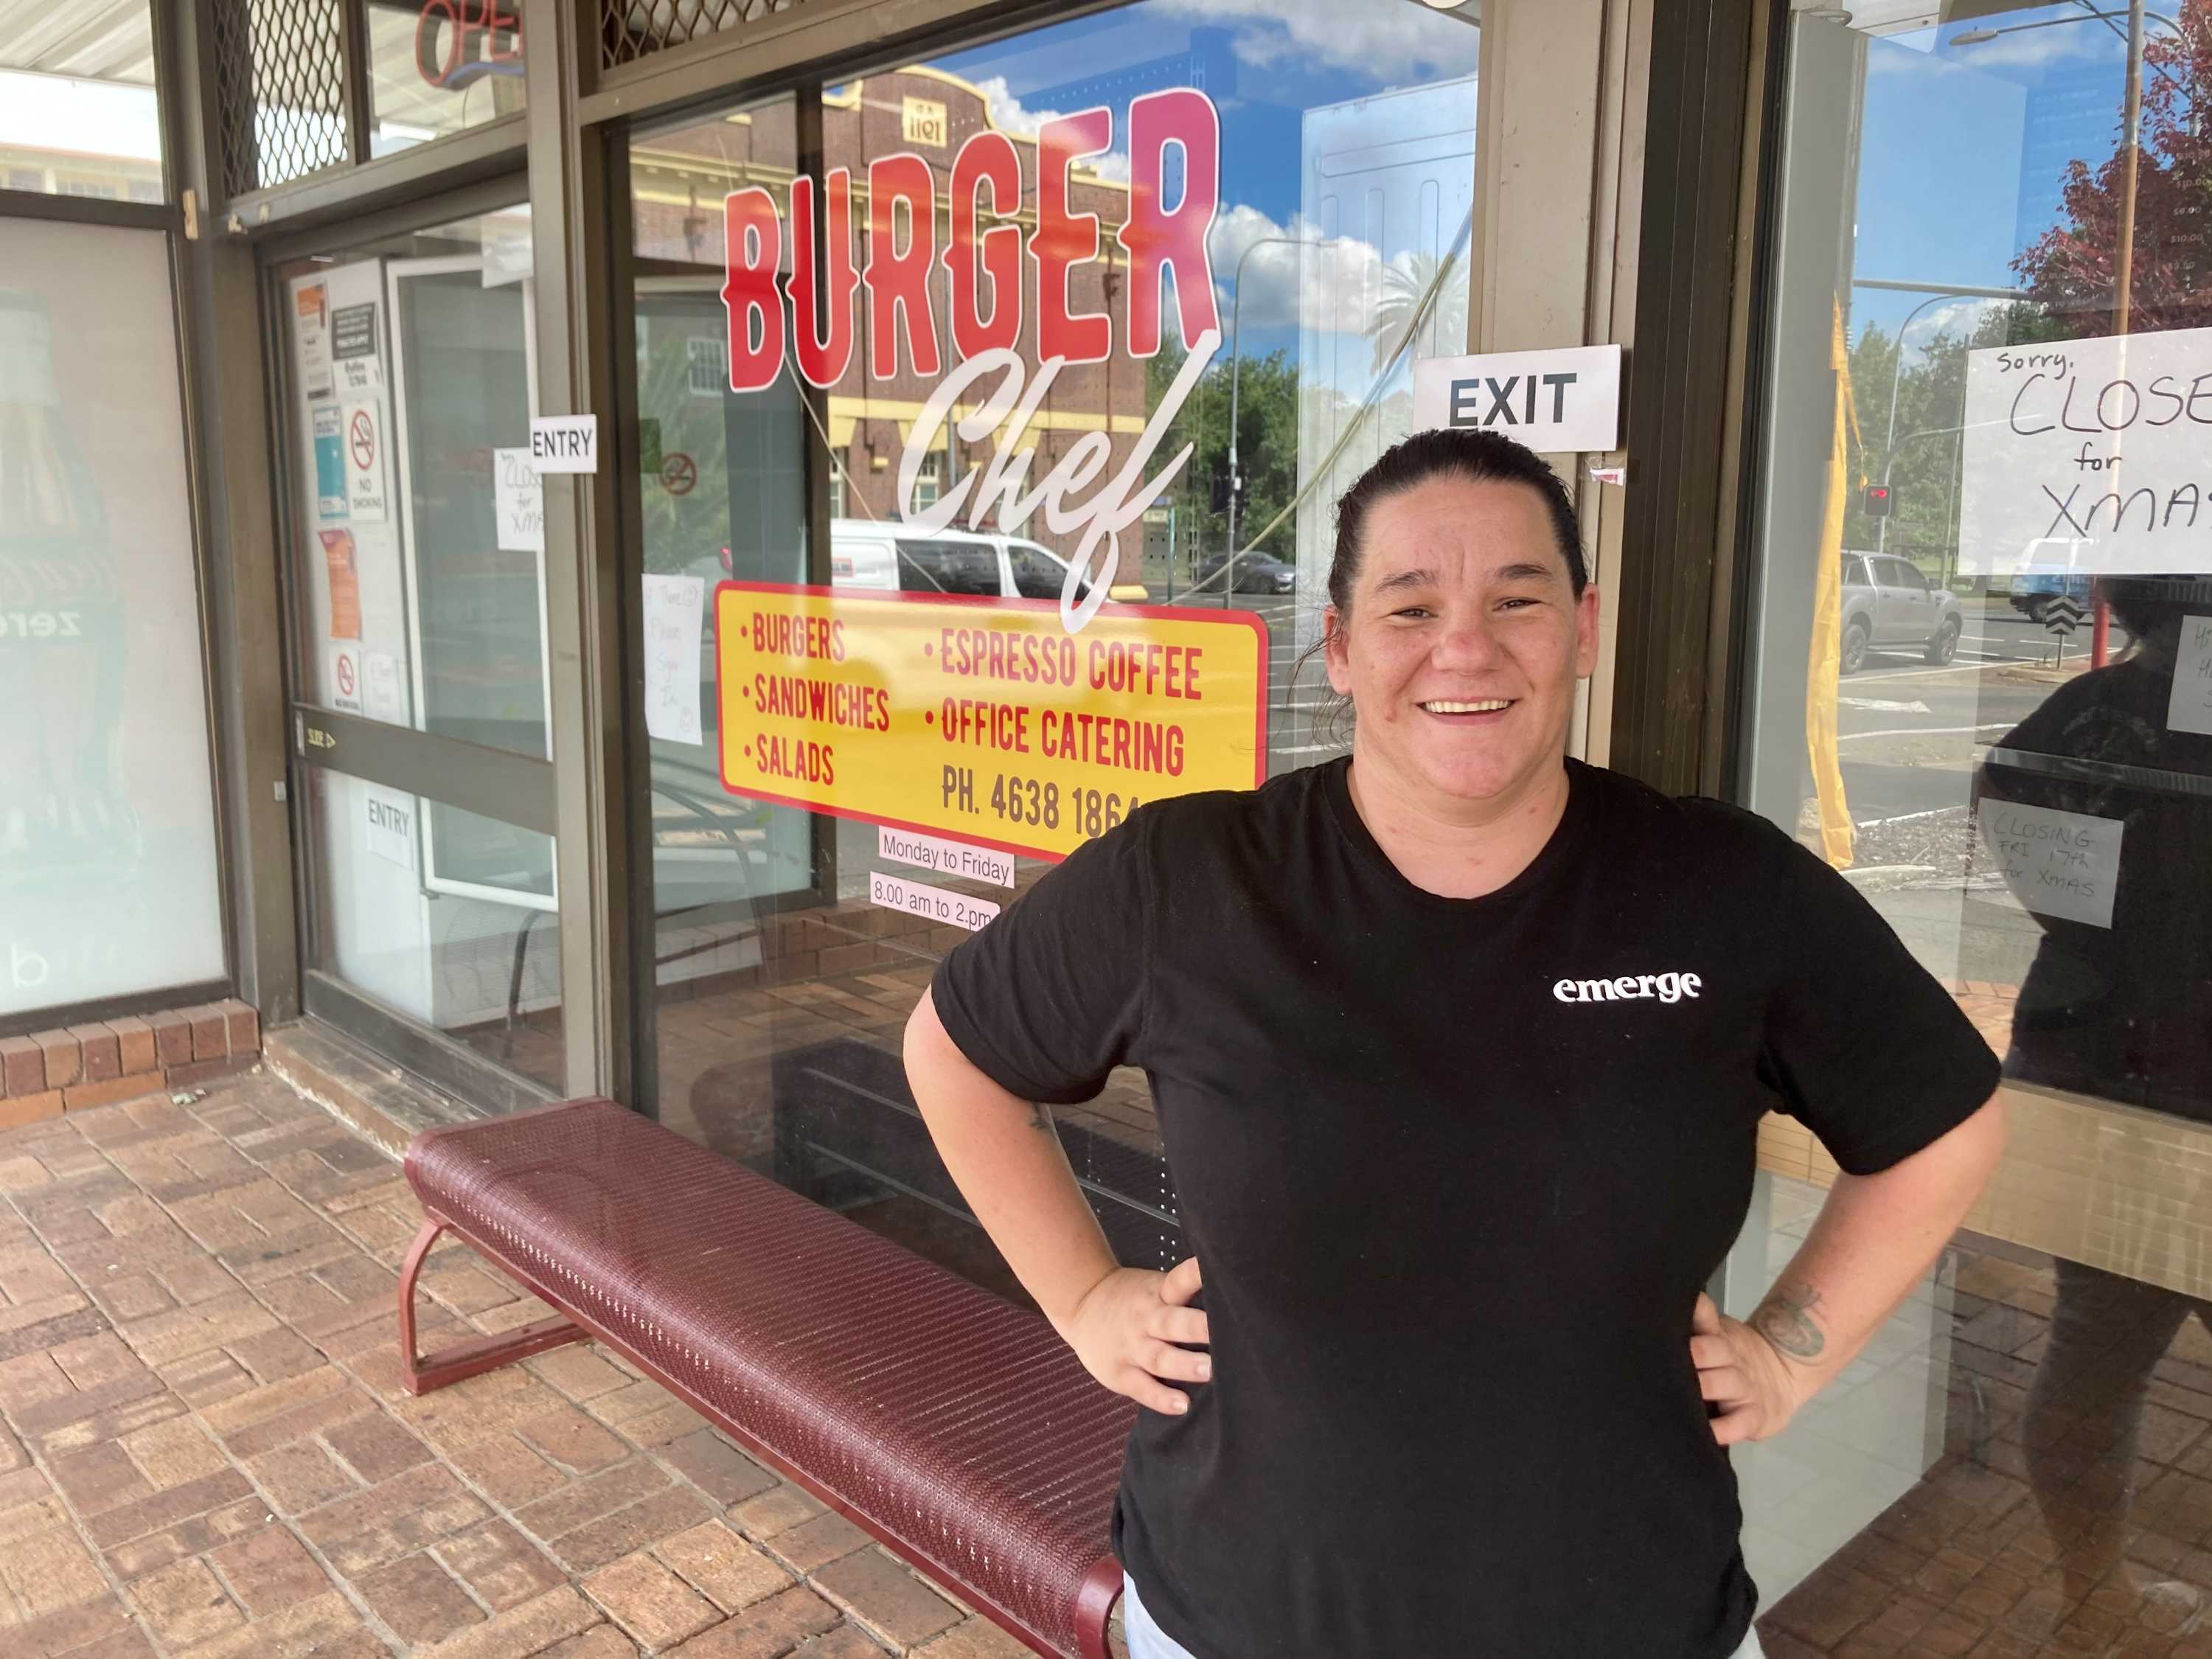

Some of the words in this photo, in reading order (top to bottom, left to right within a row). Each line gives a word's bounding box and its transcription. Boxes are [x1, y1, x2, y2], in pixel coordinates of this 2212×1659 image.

[720, 87, 1221, 393] BURGER
[1450, 372, 1577, 427] EXIT
[533, 429, 592, 458] ENTRY
[2073, 442, 2122, 471] for
[358, 478, 372, 493] NO
[897, 329, 1221, 635] Chef
[753, 612, 845, 661] BURGERS
[941, 628, 1076, 687] ESPRESSO
[1089, 640, 1203, 700] COFFEE
[755, 672, 890, 732] SANDWICHES
[757, 733, 834, 785] SALADS
[942, 697, 1029, 754] OFFICE
[1041, 709, 1184, 777] CATERING
[369, 799, 408, 838] ENTRY
[942, 765, 979, 814] PH.
[991, 774, 1059, 830] 4638
[1072, 787, 1138, 838] 186
[1994, 812, 2096, 847] CLOSING
[884, 834, 939, 869] Monday
[944, 849, 957, 869] to
[962, 852, 1009, 886] Friday
[1999, 841, 2029, 858] FRI
[2050, 849, 2088, 868] 17th
[2000, 859, 2023, 879] for
[874, 881, 903, 905] 8.00
[909, 894, 931, 914] am
[936, 900, 949, 918] to
[1553, 973, 1702, 1004] emerge
